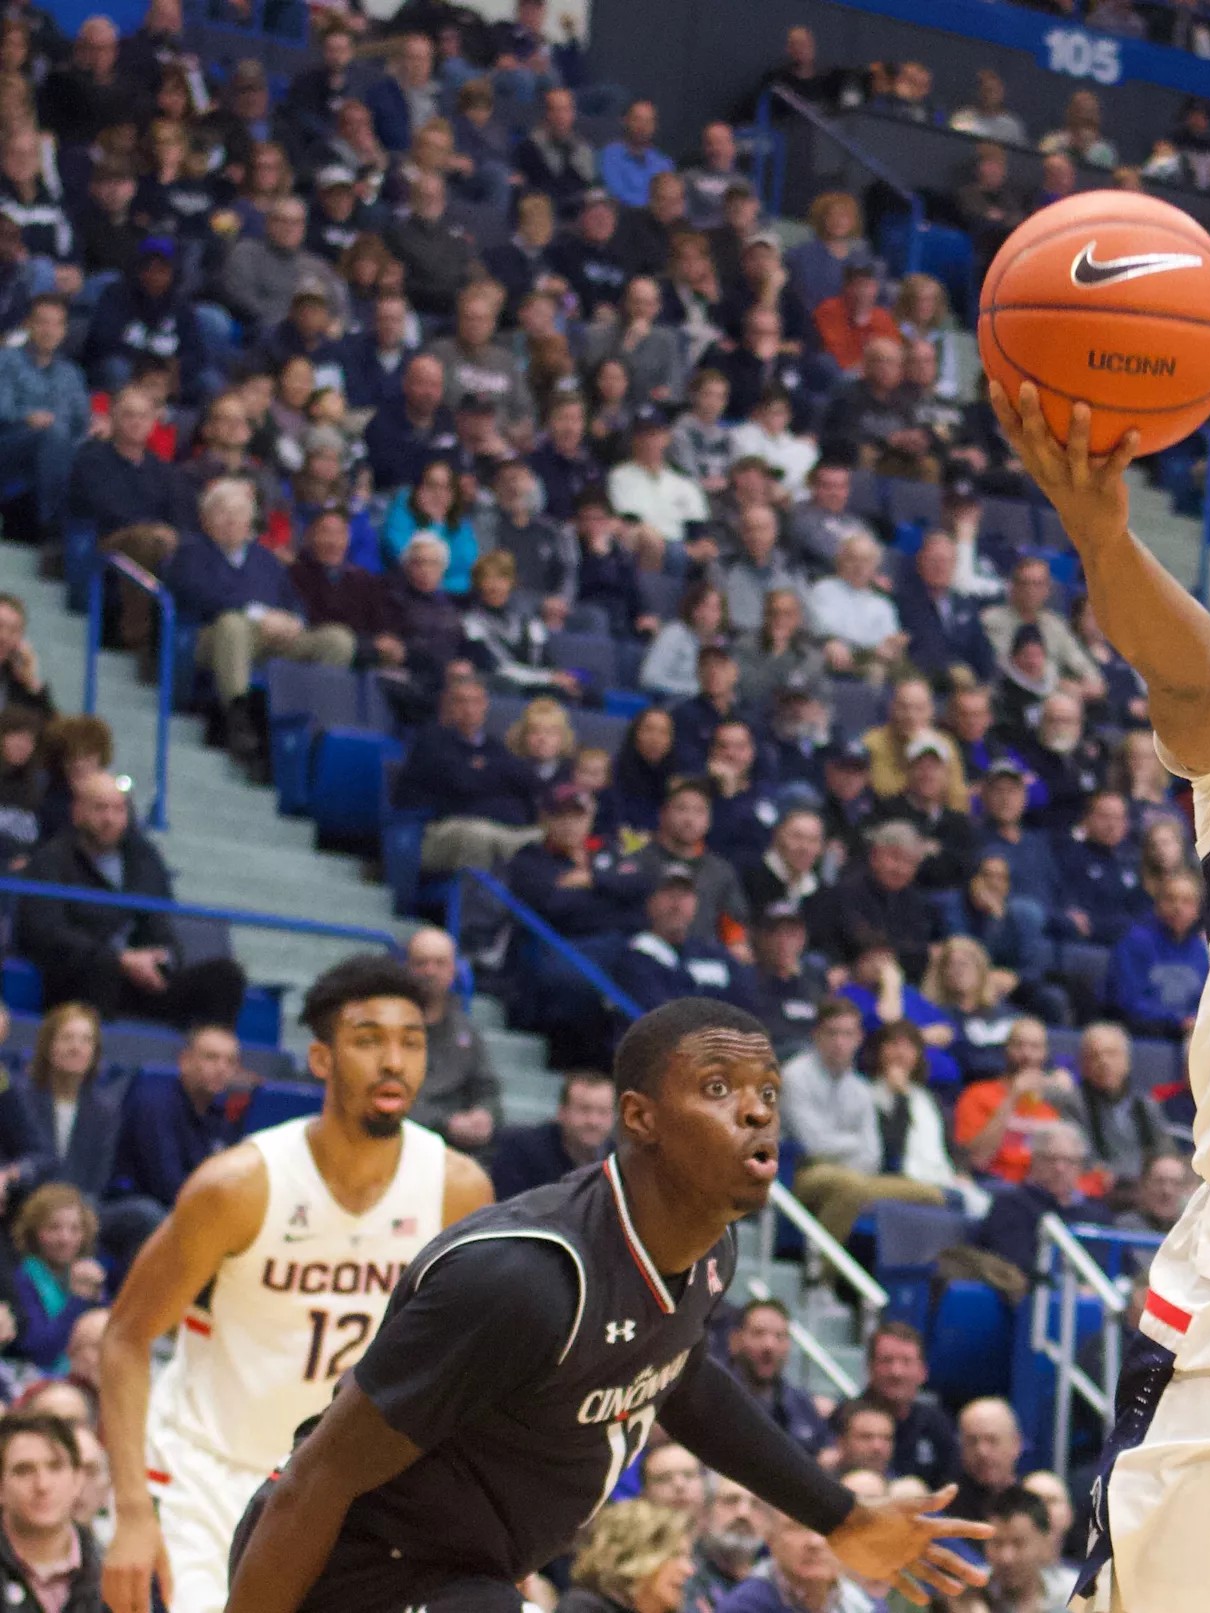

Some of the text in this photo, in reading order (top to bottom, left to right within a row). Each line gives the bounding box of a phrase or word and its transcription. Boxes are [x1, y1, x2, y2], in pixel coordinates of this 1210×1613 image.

[1046, 29, 1119, 85] 105
[1088, 350, 1176, 377] UCONN
[262, 1257, 411, 1294] UCON
[303, 1309, 373, 1381] 12
